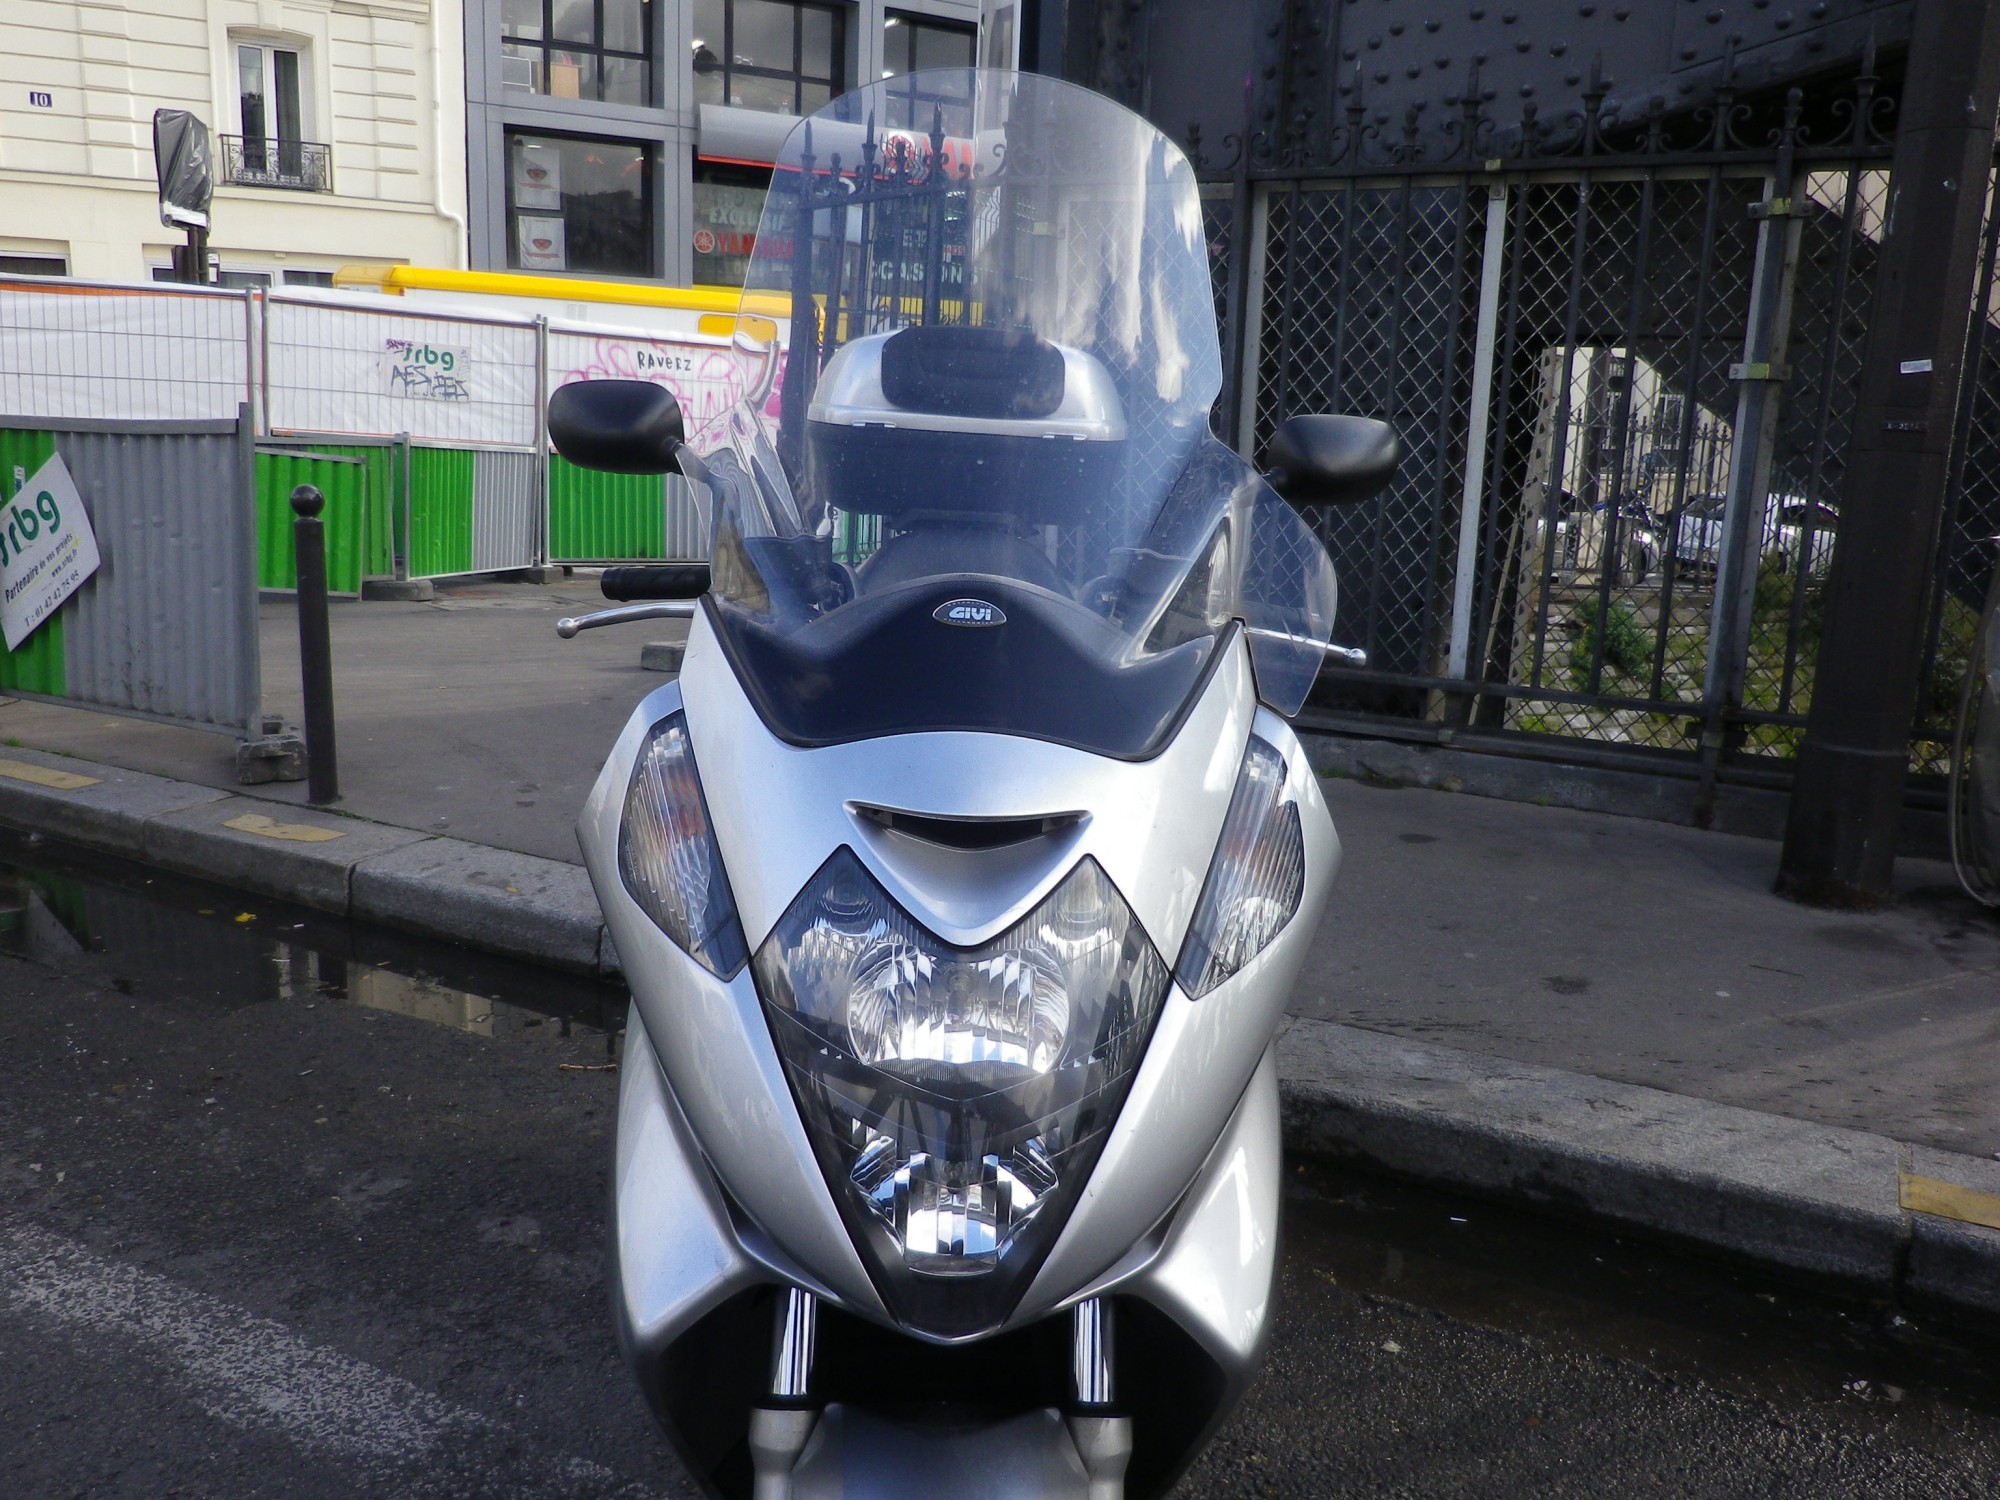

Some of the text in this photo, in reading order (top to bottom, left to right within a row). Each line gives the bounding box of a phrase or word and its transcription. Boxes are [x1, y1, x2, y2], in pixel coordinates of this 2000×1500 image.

[33, 93, 48, 107] 10
[717, 230, 795, 258] YAMAHA
[5, 564, 42, 604] Partenaire
[46, 550, 56, 563] vos
[55, 532, 73, 557] projets
[44, 596, 53, 610] 42
[53, 588, 62, 601] 42
[949, 606, 992, 621] GIVI
